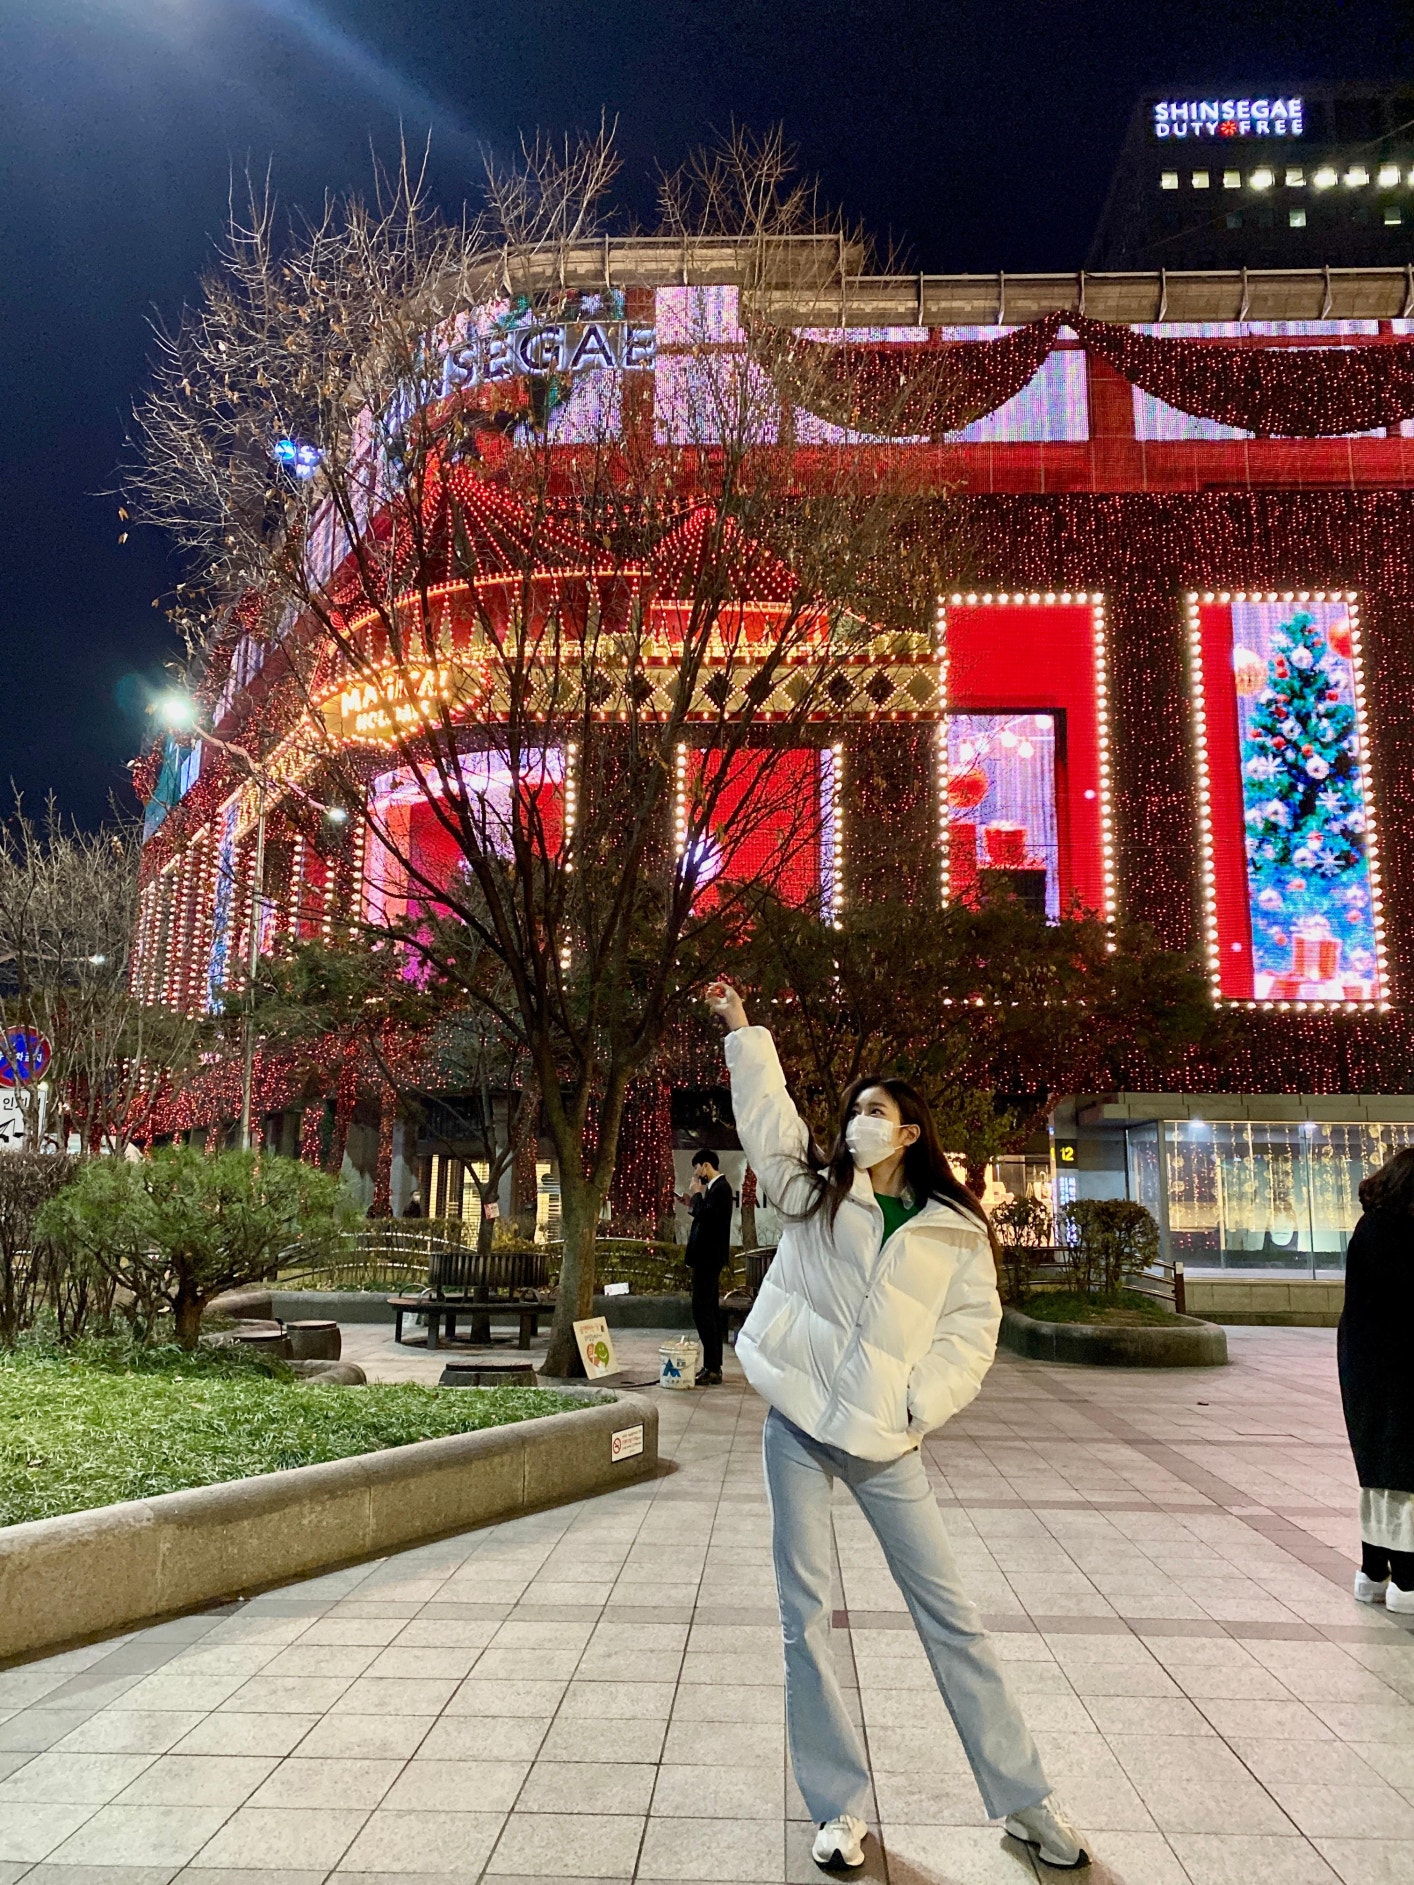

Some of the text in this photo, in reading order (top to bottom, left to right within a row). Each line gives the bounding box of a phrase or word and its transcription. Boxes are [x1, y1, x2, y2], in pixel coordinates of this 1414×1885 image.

[1155, 99, 1302, 121] SHINSEGAE
[1156, 119, 1303, 137] DUTY FREE
[1060, 1146, 1074, 1162] 12
